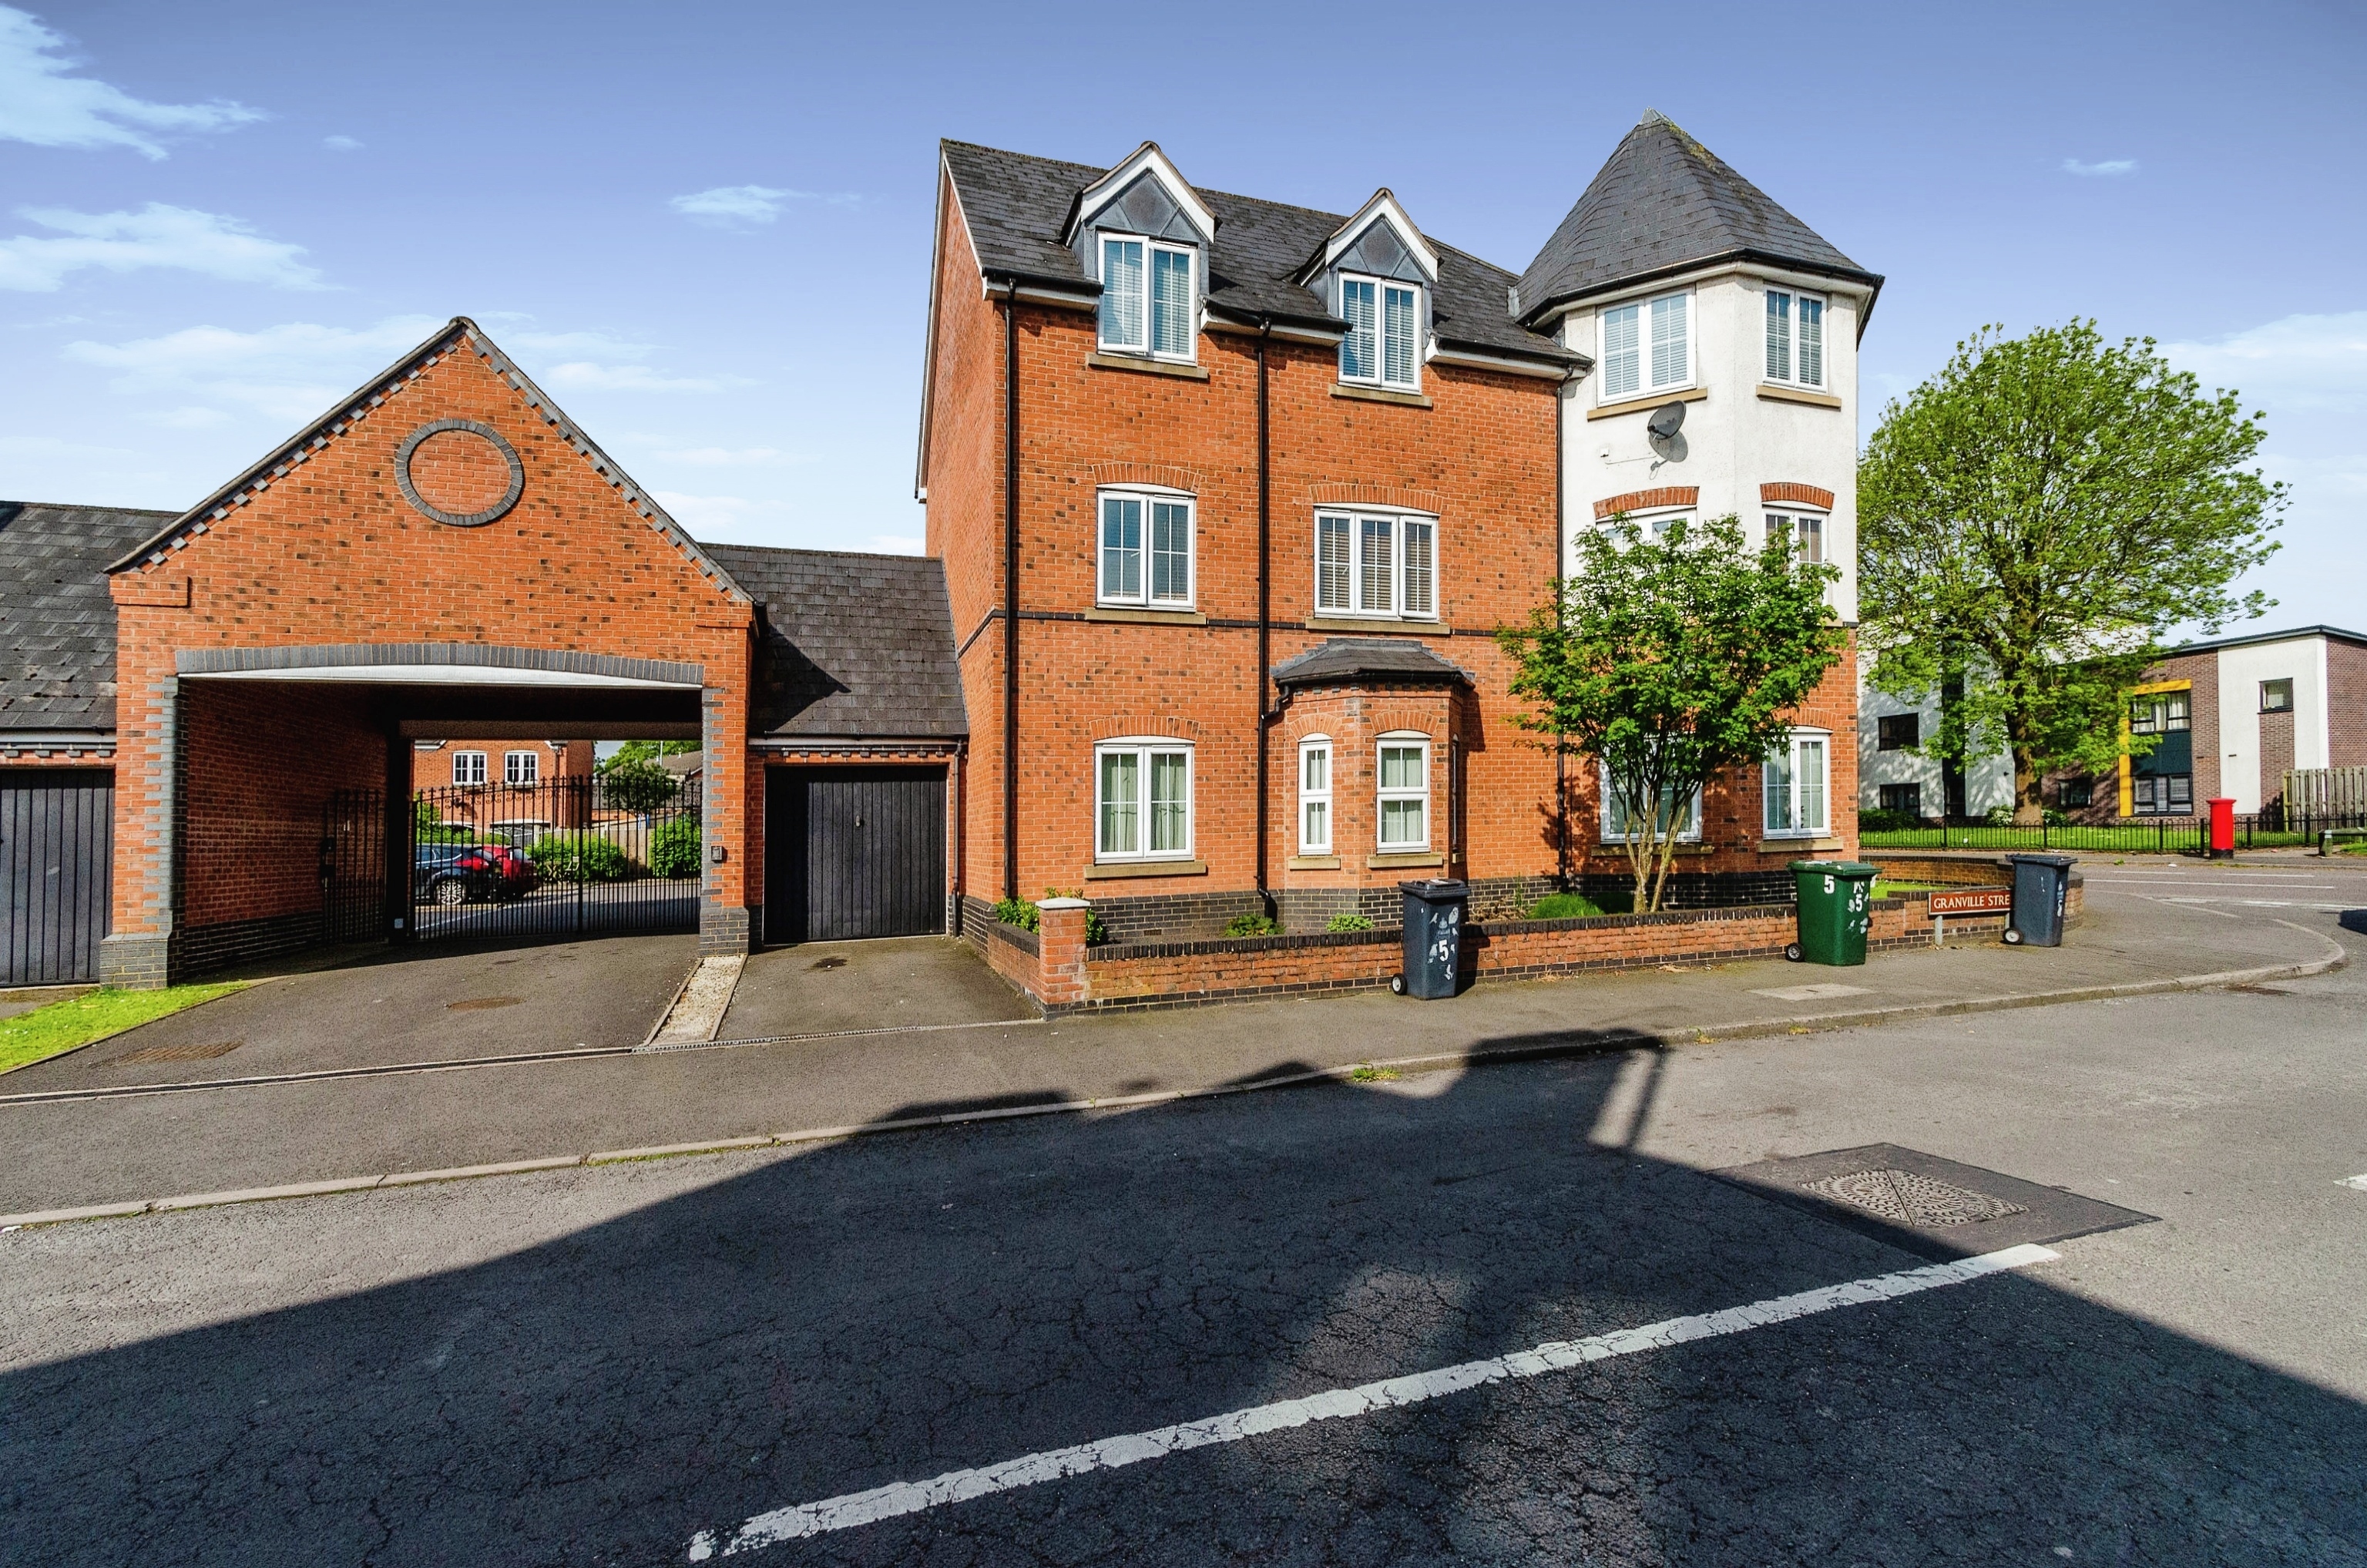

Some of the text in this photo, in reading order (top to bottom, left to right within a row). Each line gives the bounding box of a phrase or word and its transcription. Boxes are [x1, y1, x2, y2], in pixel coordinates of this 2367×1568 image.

[1824, 875, 1835, 894] 5
[1855, 894, 1862, 912] 5
[1933, 895, 2010, 909] GRANVILLE STRE
[1439, 939, 1449, 962] 5
